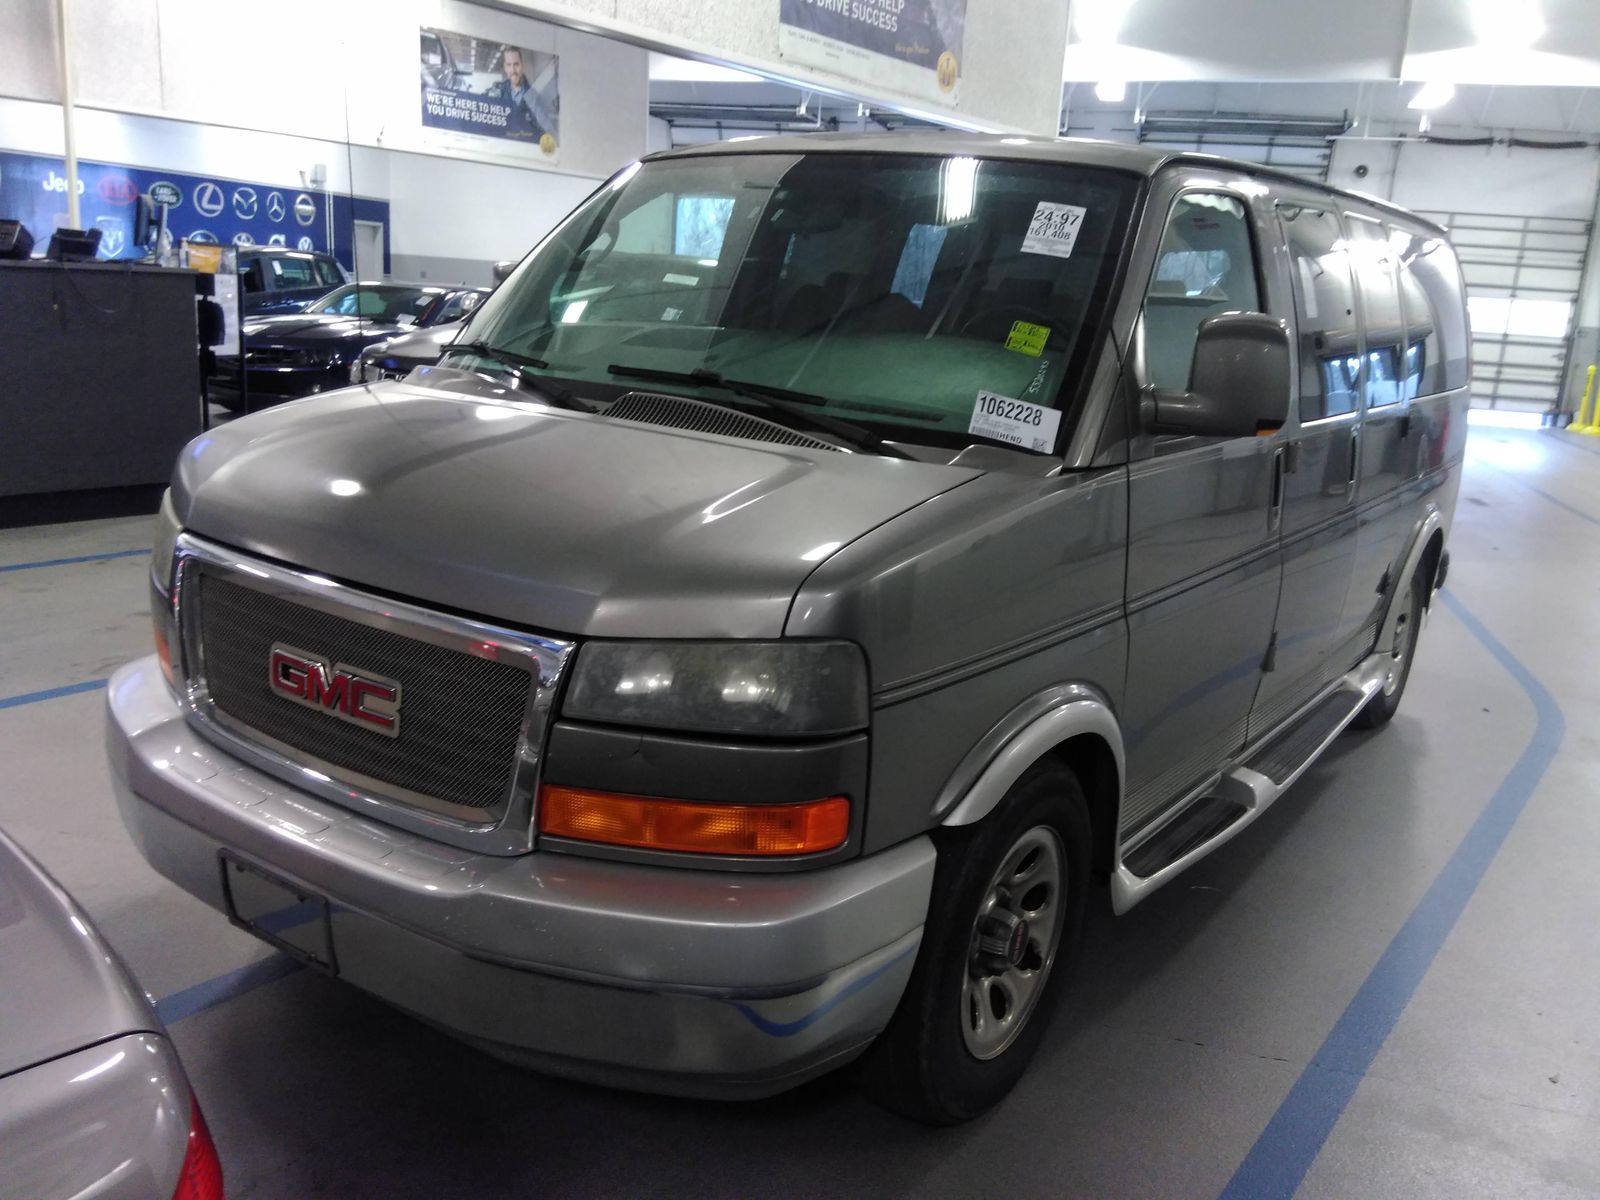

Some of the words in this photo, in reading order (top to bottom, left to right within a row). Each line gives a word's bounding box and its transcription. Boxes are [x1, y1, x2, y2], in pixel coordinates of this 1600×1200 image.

[852, 2, 898, 33] SUCCESS
[427, 93, 454, 107] WE'RE
[455, 98, 477, 111] HERE
[479, 102, 490, 112] TO
[490, 104, 511, 116] HELP
[427, 103, 445, 116] YOU
[446, 106, 470, 120] DRIVE
[471, 111, 507, 127] SUCCESS
[43, 171, 85, 194] Jep
[980, 395, 1043, 426] 1062228
[272, 649, 397, 729] GMC
